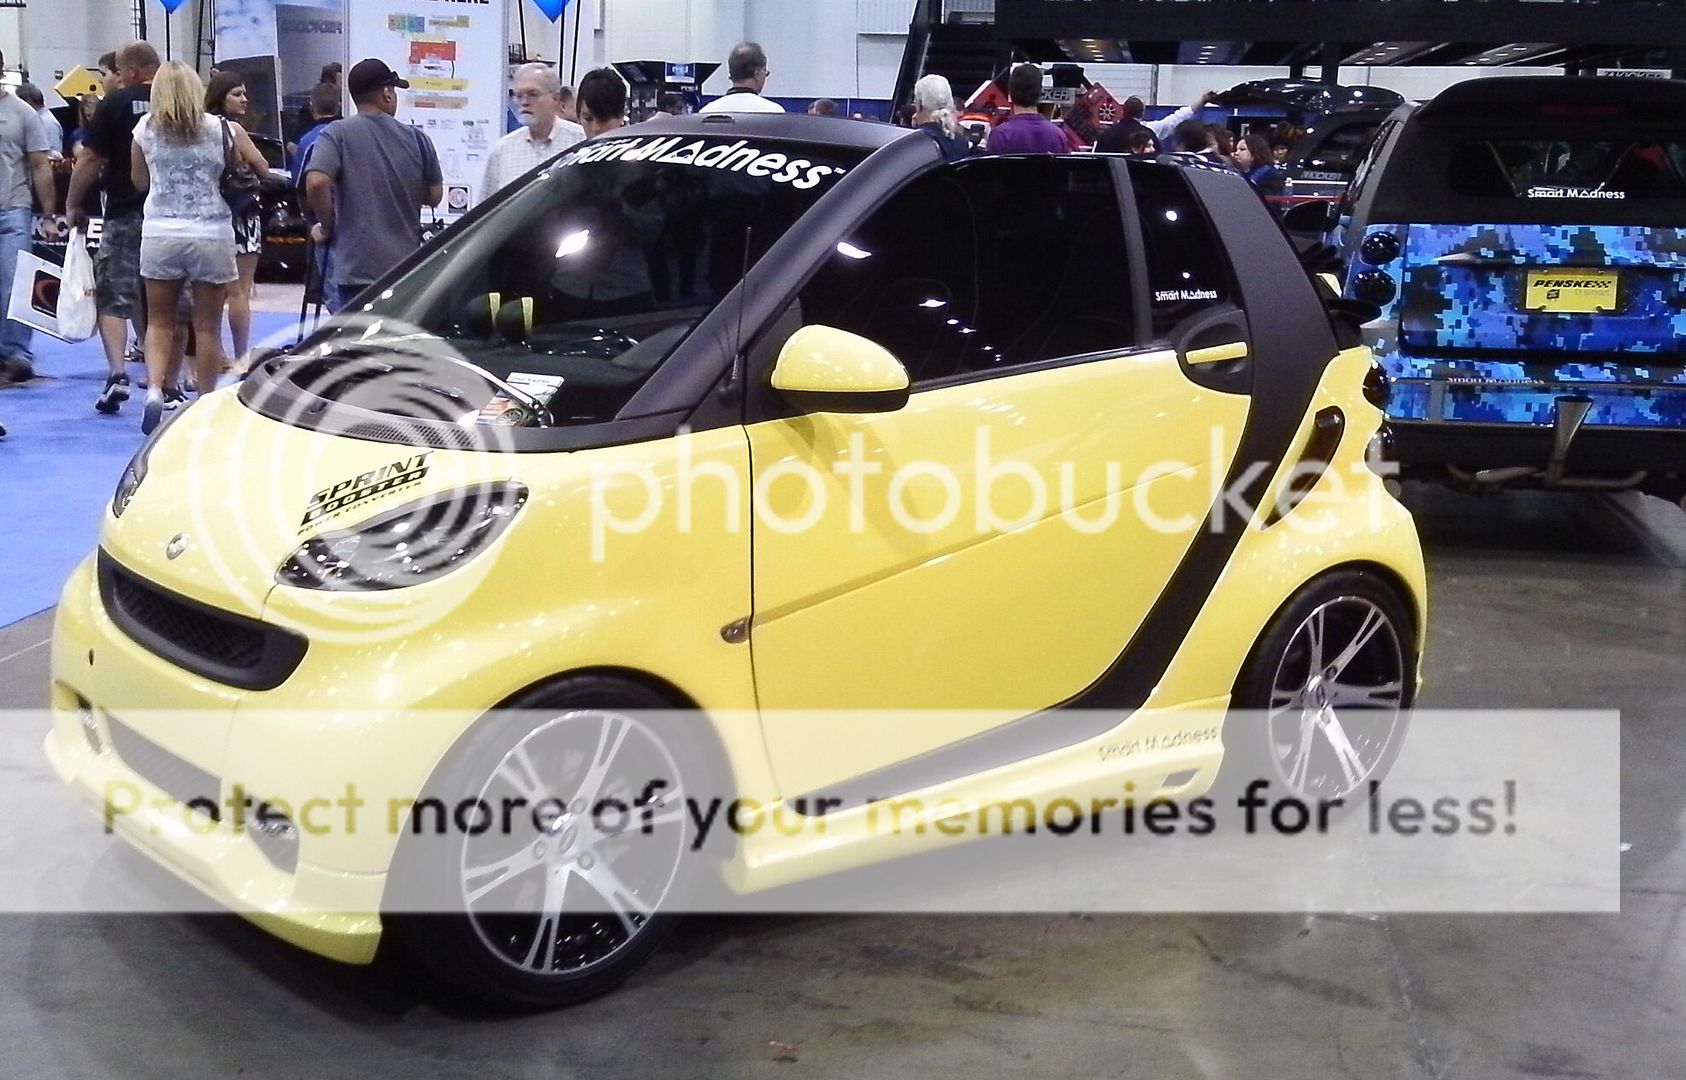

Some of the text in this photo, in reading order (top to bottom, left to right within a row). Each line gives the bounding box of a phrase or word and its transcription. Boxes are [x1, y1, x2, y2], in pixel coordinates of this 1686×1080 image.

[1527, 187, 1564, 199] Smart
[1533, 279, 1594, 289] PENSKE
[1155, 290, 1180, 302] Smart
[308, 450, 434, 505] SPRINT
[300, 466, 430, 527] BOOSTER
